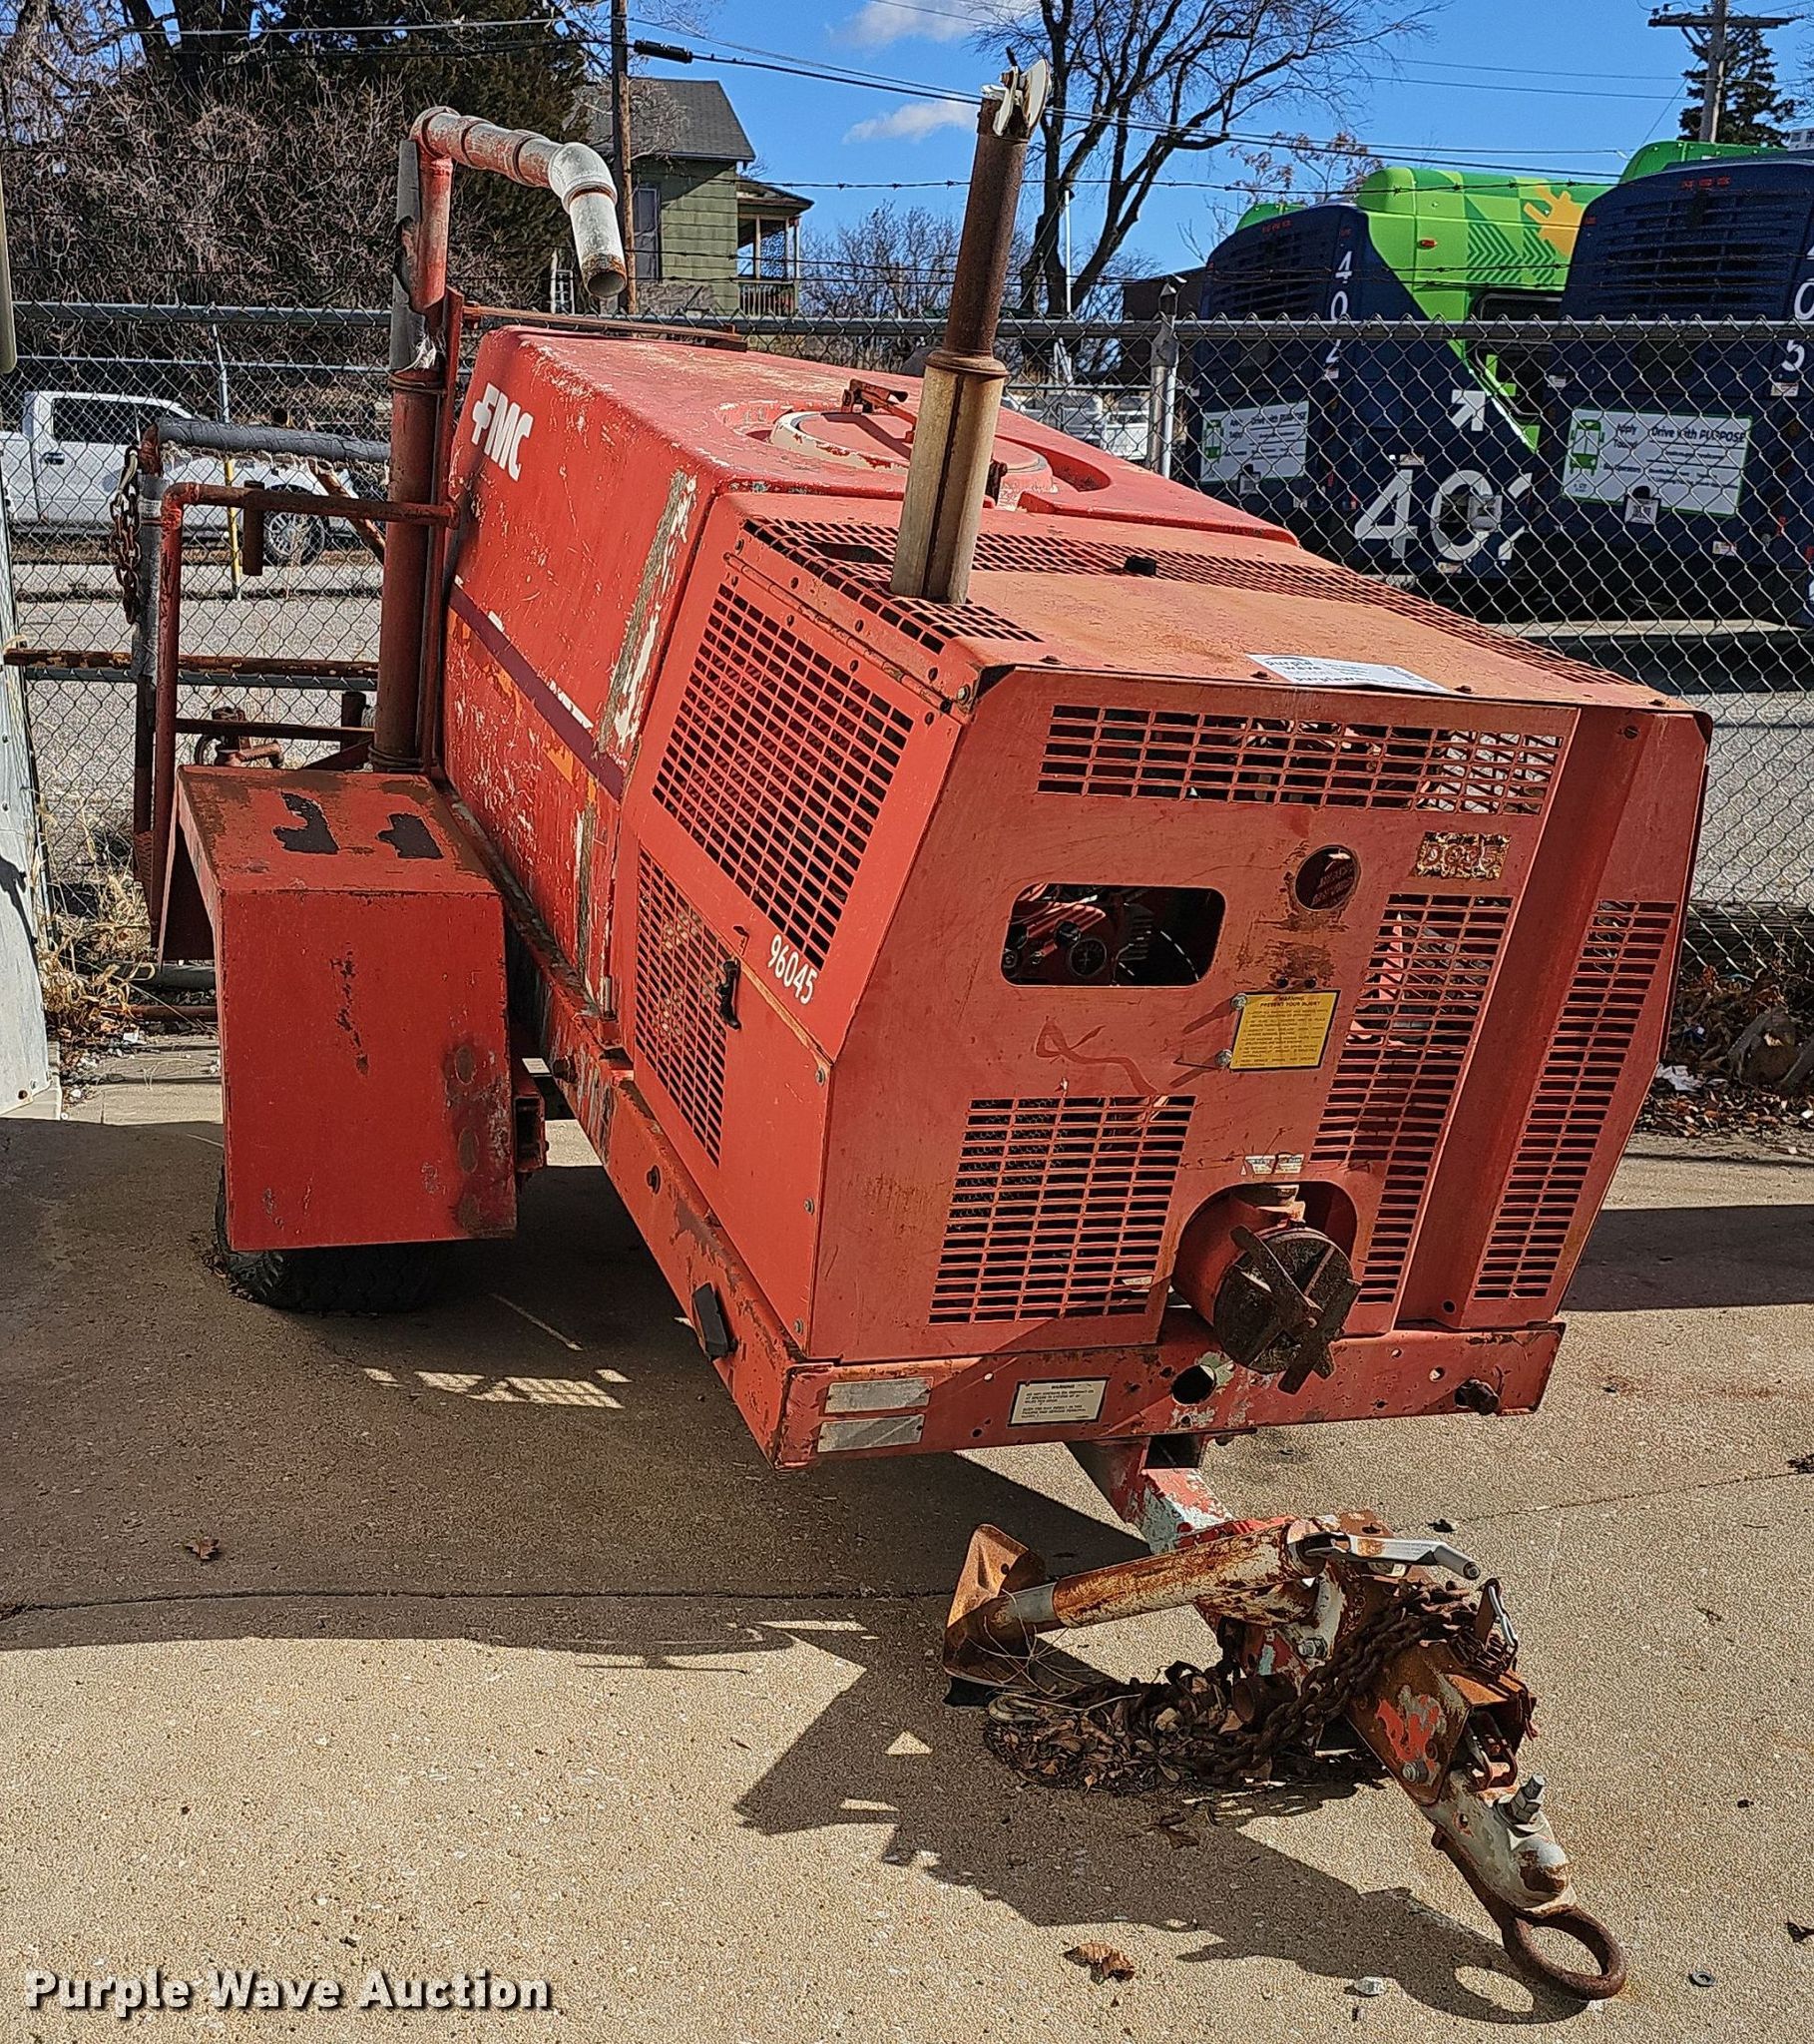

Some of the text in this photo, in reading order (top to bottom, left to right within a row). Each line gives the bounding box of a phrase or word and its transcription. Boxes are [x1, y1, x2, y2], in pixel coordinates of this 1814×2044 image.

[472, 382, 534, 482] FMC
[1651, 425, 1674, 439] Drive
[767, 934, 818, 1005] 96045
